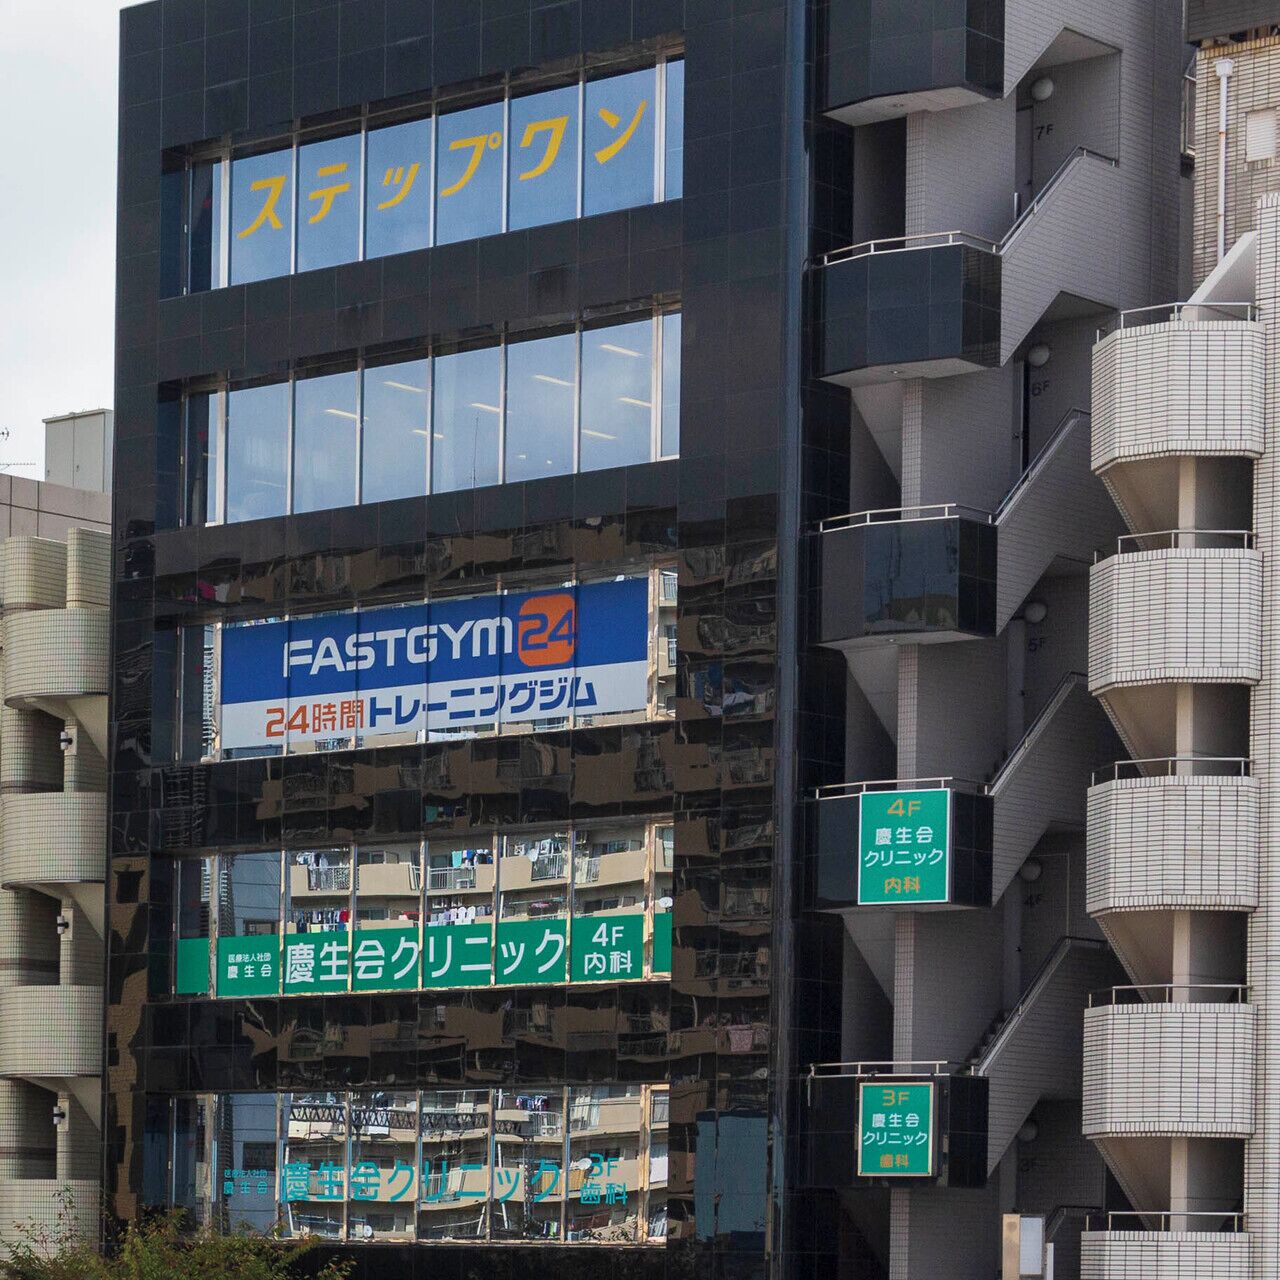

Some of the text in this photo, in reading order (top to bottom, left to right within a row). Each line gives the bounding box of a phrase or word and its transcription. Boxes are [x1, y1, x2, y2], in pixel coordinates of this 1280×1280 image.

[238, 101, 647, 239] ステップワン
[283, 607, 576, 677] FASTGYM 24
[266, 677, 597, 738] 24時間トレーニングジム
[888, 799, 922, 817] 4F
[875, 827, 934, 845] 慶生会
[865, 849, 944, 867] クリニック
[884, 877, 921, 894] 内科
[592, 923, 624, 947] 4F
[286, 929, 565, 983] 慶生会クリニック
[584, 950, 633, 977] 内科
[228, 964, 272, 979] 慶生会
[883, 1090, 910, 1106] 3F
[872, 1113, 920, 1128] 慶生会
[863, 1131, 928, 1146] クリニック
[588, 1153, 618, 1176] 3F
[880, 1154, 910, 1168] 歯科
[281, 1158, 562, 1204] 慶生会クリニック
[581, 1182, 629, 1206] 歯科
